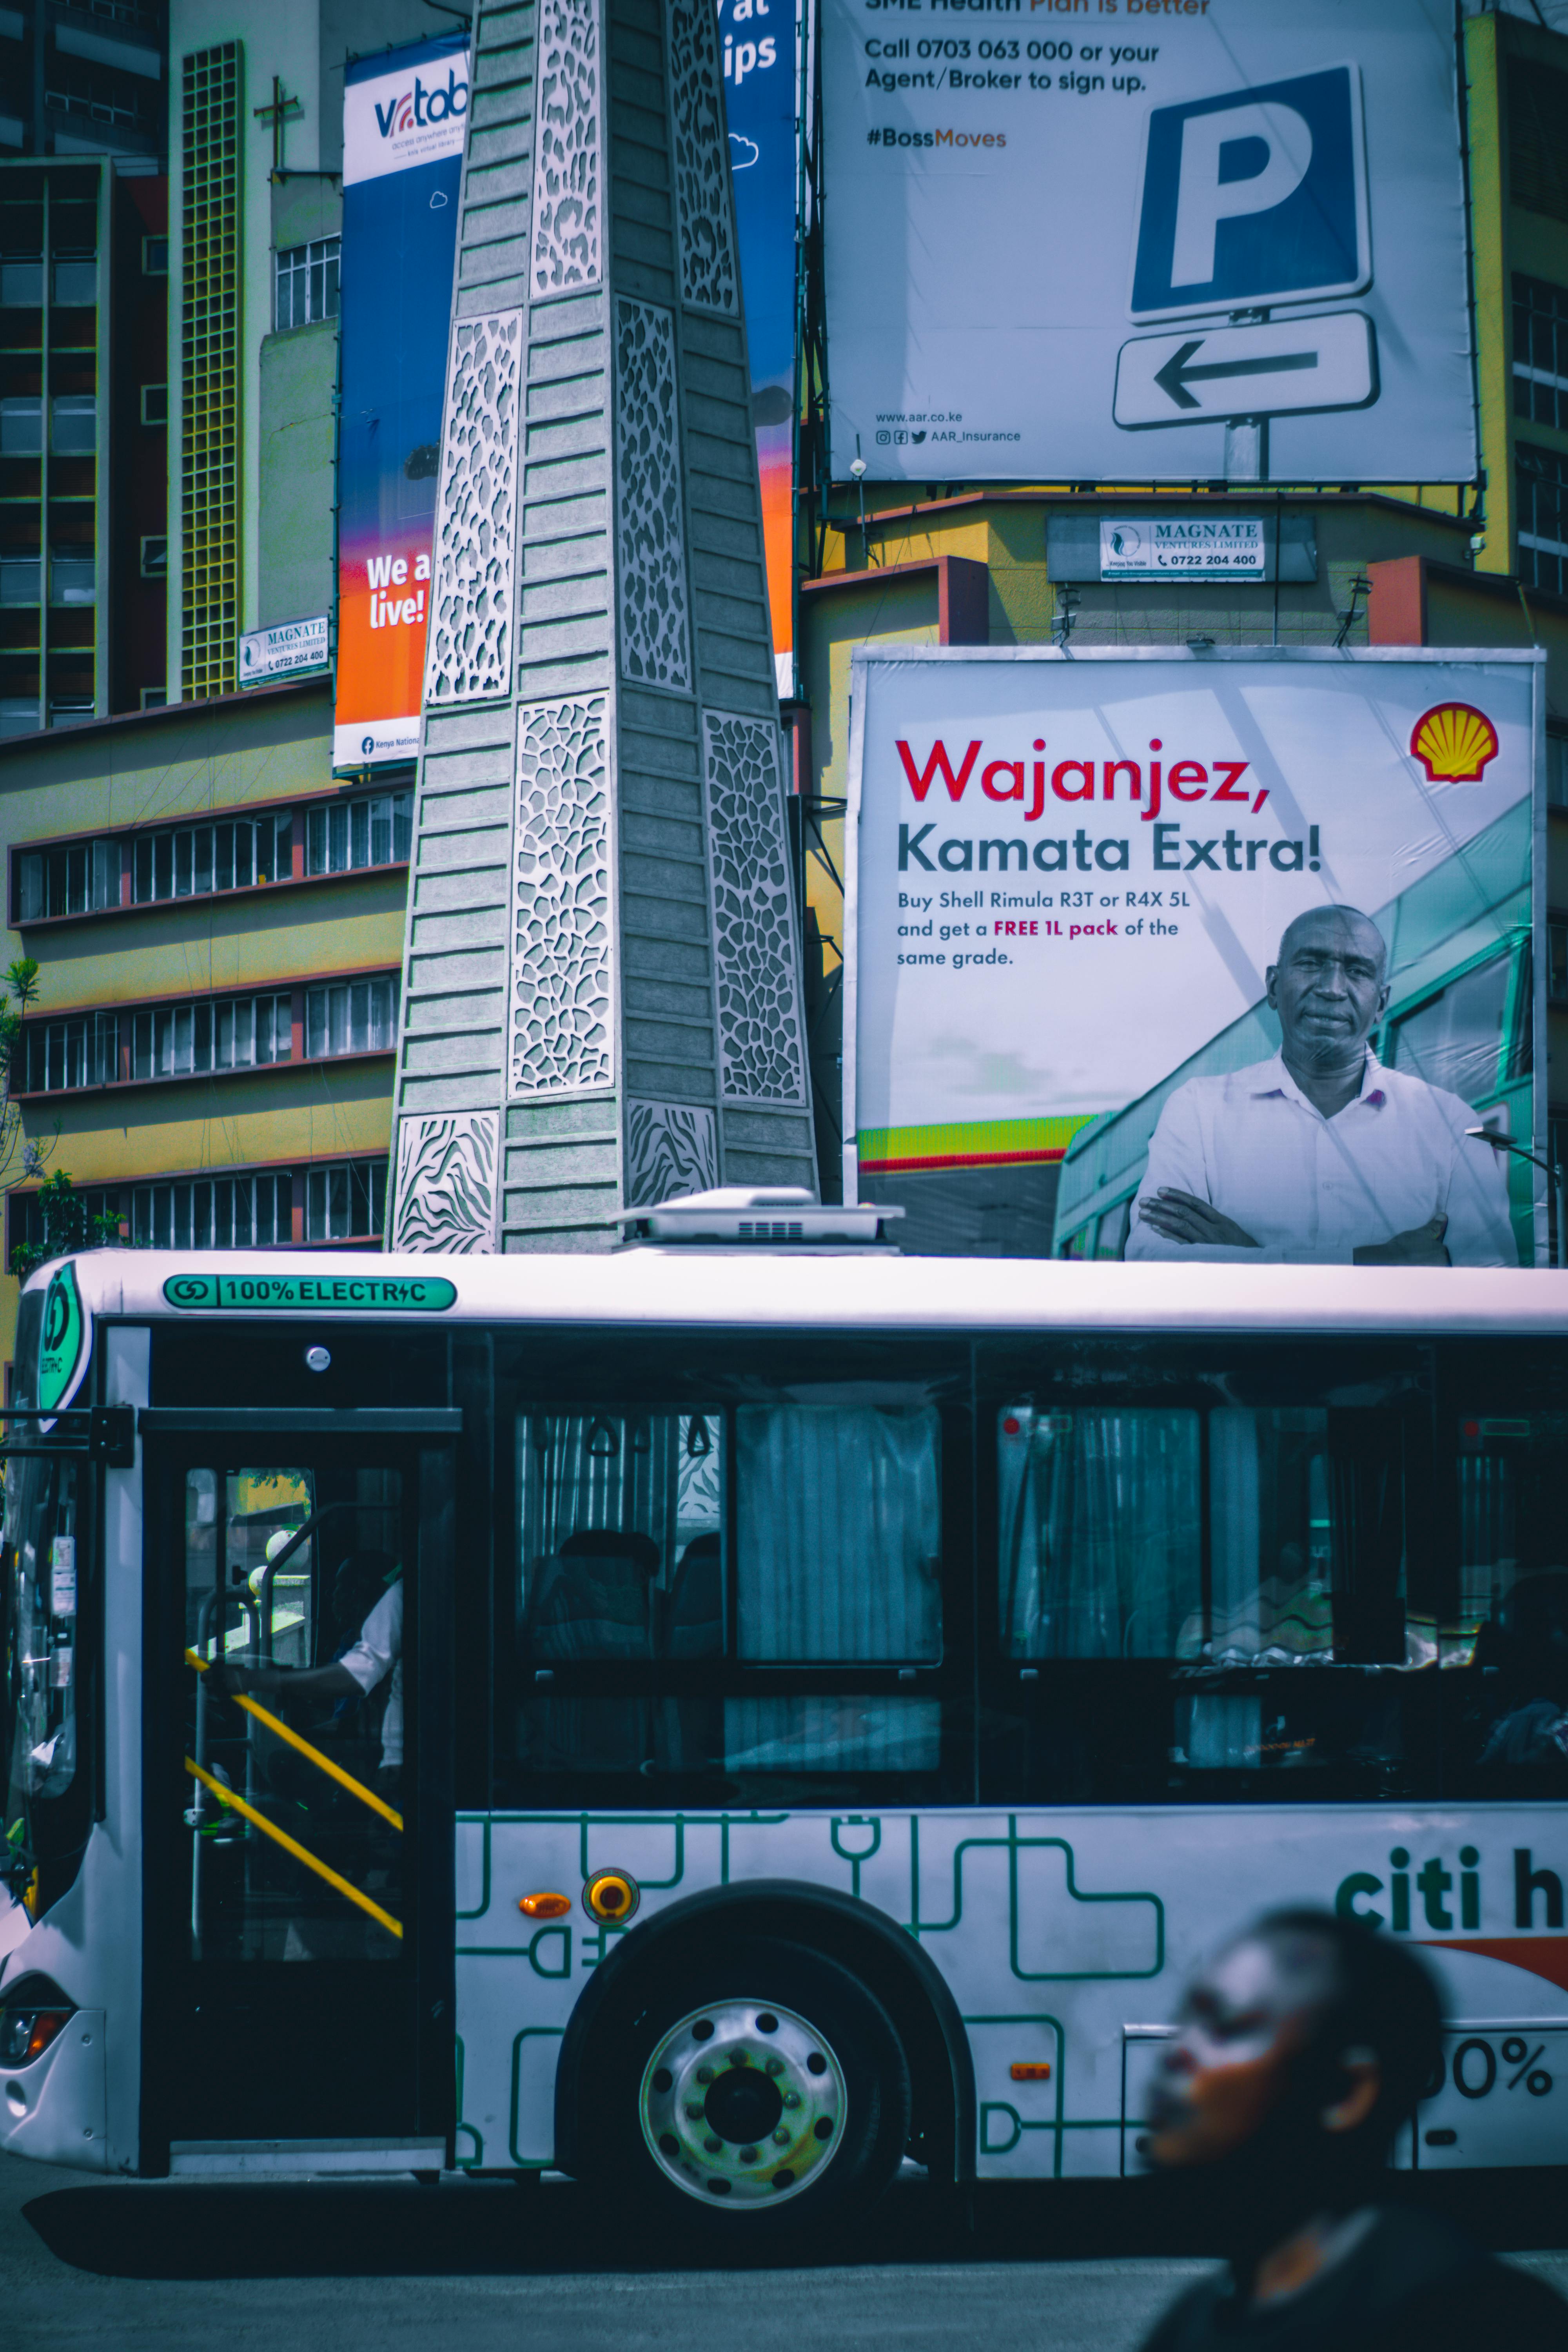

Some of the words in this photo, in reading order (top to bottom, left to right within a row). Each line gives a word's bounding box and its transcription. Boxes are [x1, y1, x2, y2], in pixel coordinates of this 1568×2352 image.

[1030, 0, 1088, 12] Plan
[1099, 0, 1117, 13] is
[1127, 0, 1210, 15] better
[865, 39, 909, 59] Call
[917, 40, 971, 59] 0703
[978, 41, 1020, 60] 063
[1026, 42, 1073, 61] 000
[1080, 46, 1102, 61] or
[1110, 46, 1159, 65] your
[865, 67, 1022, 92] Agent/Broker
[1029, 71, 1052, 90] to
[1059, 71, 1105, 94] sign
[1112, 76, 1147, 96] up.
[867, 129, 1007, 148] #BossMoves
[1171, 101, 1312, 289] P
[876, 412, 962, 422] www.aar.co.ke
[931, 431, 1021, 443] AAR_Insurance
[1155, 524, 1258, 538] MAGNATE
[1155, 541, 1211, 549] VENTURES
[1214, 541, 1258, 549] LIMITED
[1171, 555, 1202, 565] 0722
[1207, 555, 1229, 565] 204
[1233, 555, 1256, 565] 400
[367, 555, 408, 590] We
[370, 590, 425, 629] live!
[268, 622, 325, 646] MAGNATE
[267, 643, 298, 656] VENTURES
[299, 637, 326, 648] LIMITED
[276, 657, 292, 668] 0722
[294, 653, 308, 664] 204
[310, 650, 324, 660] 400
[376, 740, 394, 749] Kenya
[895, 738, 1270, 822] Wajanjez,
[898, 822, 1130, 873] Kamata
[1152, 824, 1321, 872] Extra!
[898, 893, 933, 912] Buy
[939, 891, 983, 908] Shell
[991, 891, 1053, 908] Rimula
[1060, 892, 1094, 907] R3T
[1100, 896, 1120, 907] or
[1126, 892, 1163, 907] R4X
[1169, 892, 1190, 907] 5L
[898, 920, 933, 936] and
[939, 921, 969, 941] get
[976, 924, 987, 936] a
[994, 921, 1038, 936] FREE
[1046, 921, 1063, 935] 1L
[1069, 919, 1118, 940] pack
[1125, 918, 1144, 935] of
[1149, 918, 1179, 935] the
[897, 953, 946, 965] same
[953, 948, 1013, 969] grade.
[226, 1280, 294, 1301] 100%
[1335, 1845, 1480, 1932] citi
[1514, 1848, 1564, 1929] h
